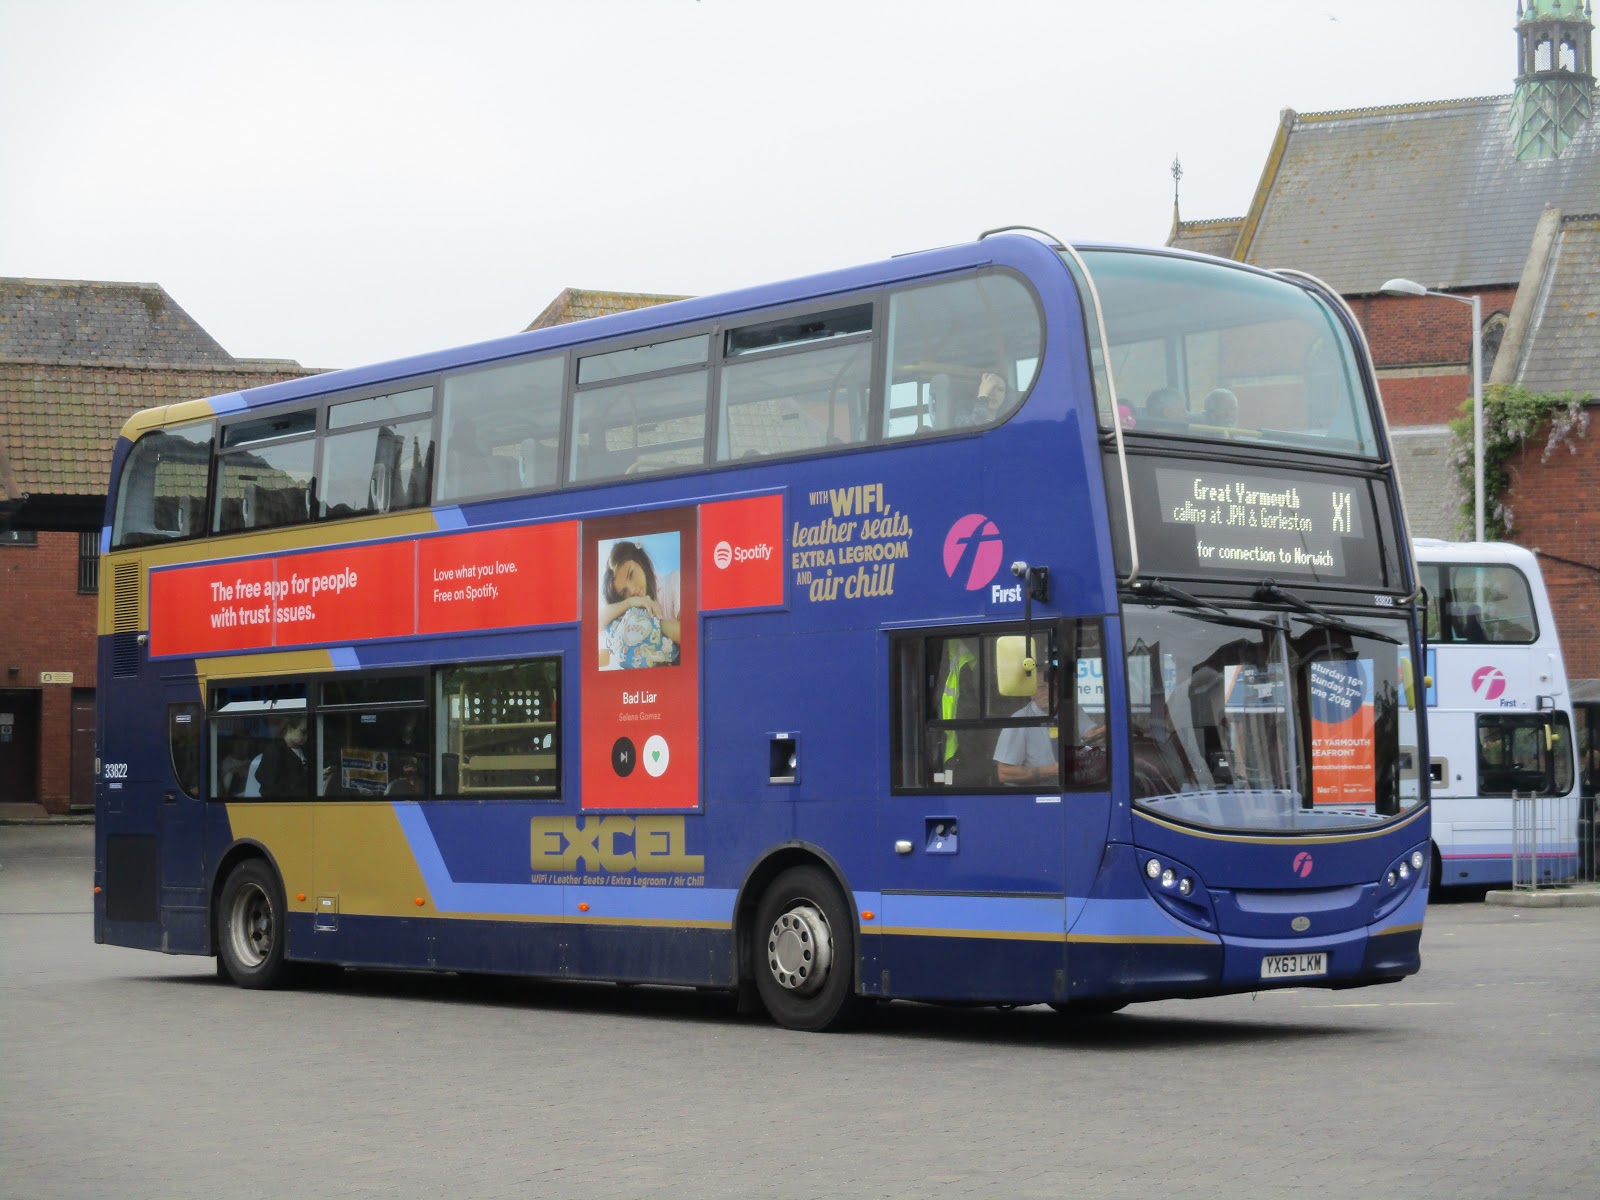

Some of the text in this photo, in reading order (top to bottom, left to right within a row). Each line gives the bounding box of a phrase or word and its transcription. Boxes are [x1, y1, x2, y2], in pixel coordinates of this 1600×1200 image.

[809, 482, 891, 517] WITH WIFI,
[1193, 479, 1300, 509] Great Yarmouth
[1173, 500, 1313, 532] calling at JPH & Gorleston
[1332, 491, 1351, 532] X1
[792, 511, 913, 548] leather seats,
[734, 542, 772, 564] Spotify
[792, 541, 909, 569] EXTRA LEGROOM
[1197, 540, 1334, 567] for connection to Norwich
[433, 560, 518, 581] Love what you love.
[211, 567, 357, 602] The free app for people
[796, 562, 896, 602] AND air chill
[433, 583, 499, 603] Free on Spotify.
[992, 584, 1022, 604] First
[211, 603, 316, 628] with trust issues.
[1311, 673, 1344, 694] Sunday
[622, 690, 658, 705] Bad Liar
[1328, 693, 1352, 708] 2018
[1500, 698, 1517, 708] First
[618, 711, 662, 722] Selena Gomez
[1311, 748, 1356, 757] SEAFRONT
[1324, 738, 1371, 747] YARMOUTH
[105, 763, 128, 778] 33822
[530, 815, 705, 873] EXCEL
[530, 874, 548, 884] WiFi
[553, 874, 582, 885] Leather
[583, 875, 605, 886] Seats
[611, 875, 632, 886] Extra
[633, 875, 667, 888] Legroom
[673, 875, 686, 887] Air
[686, 875, 705, 887] Chill
[1266, 954, 1321, 974] YX63 LKM
